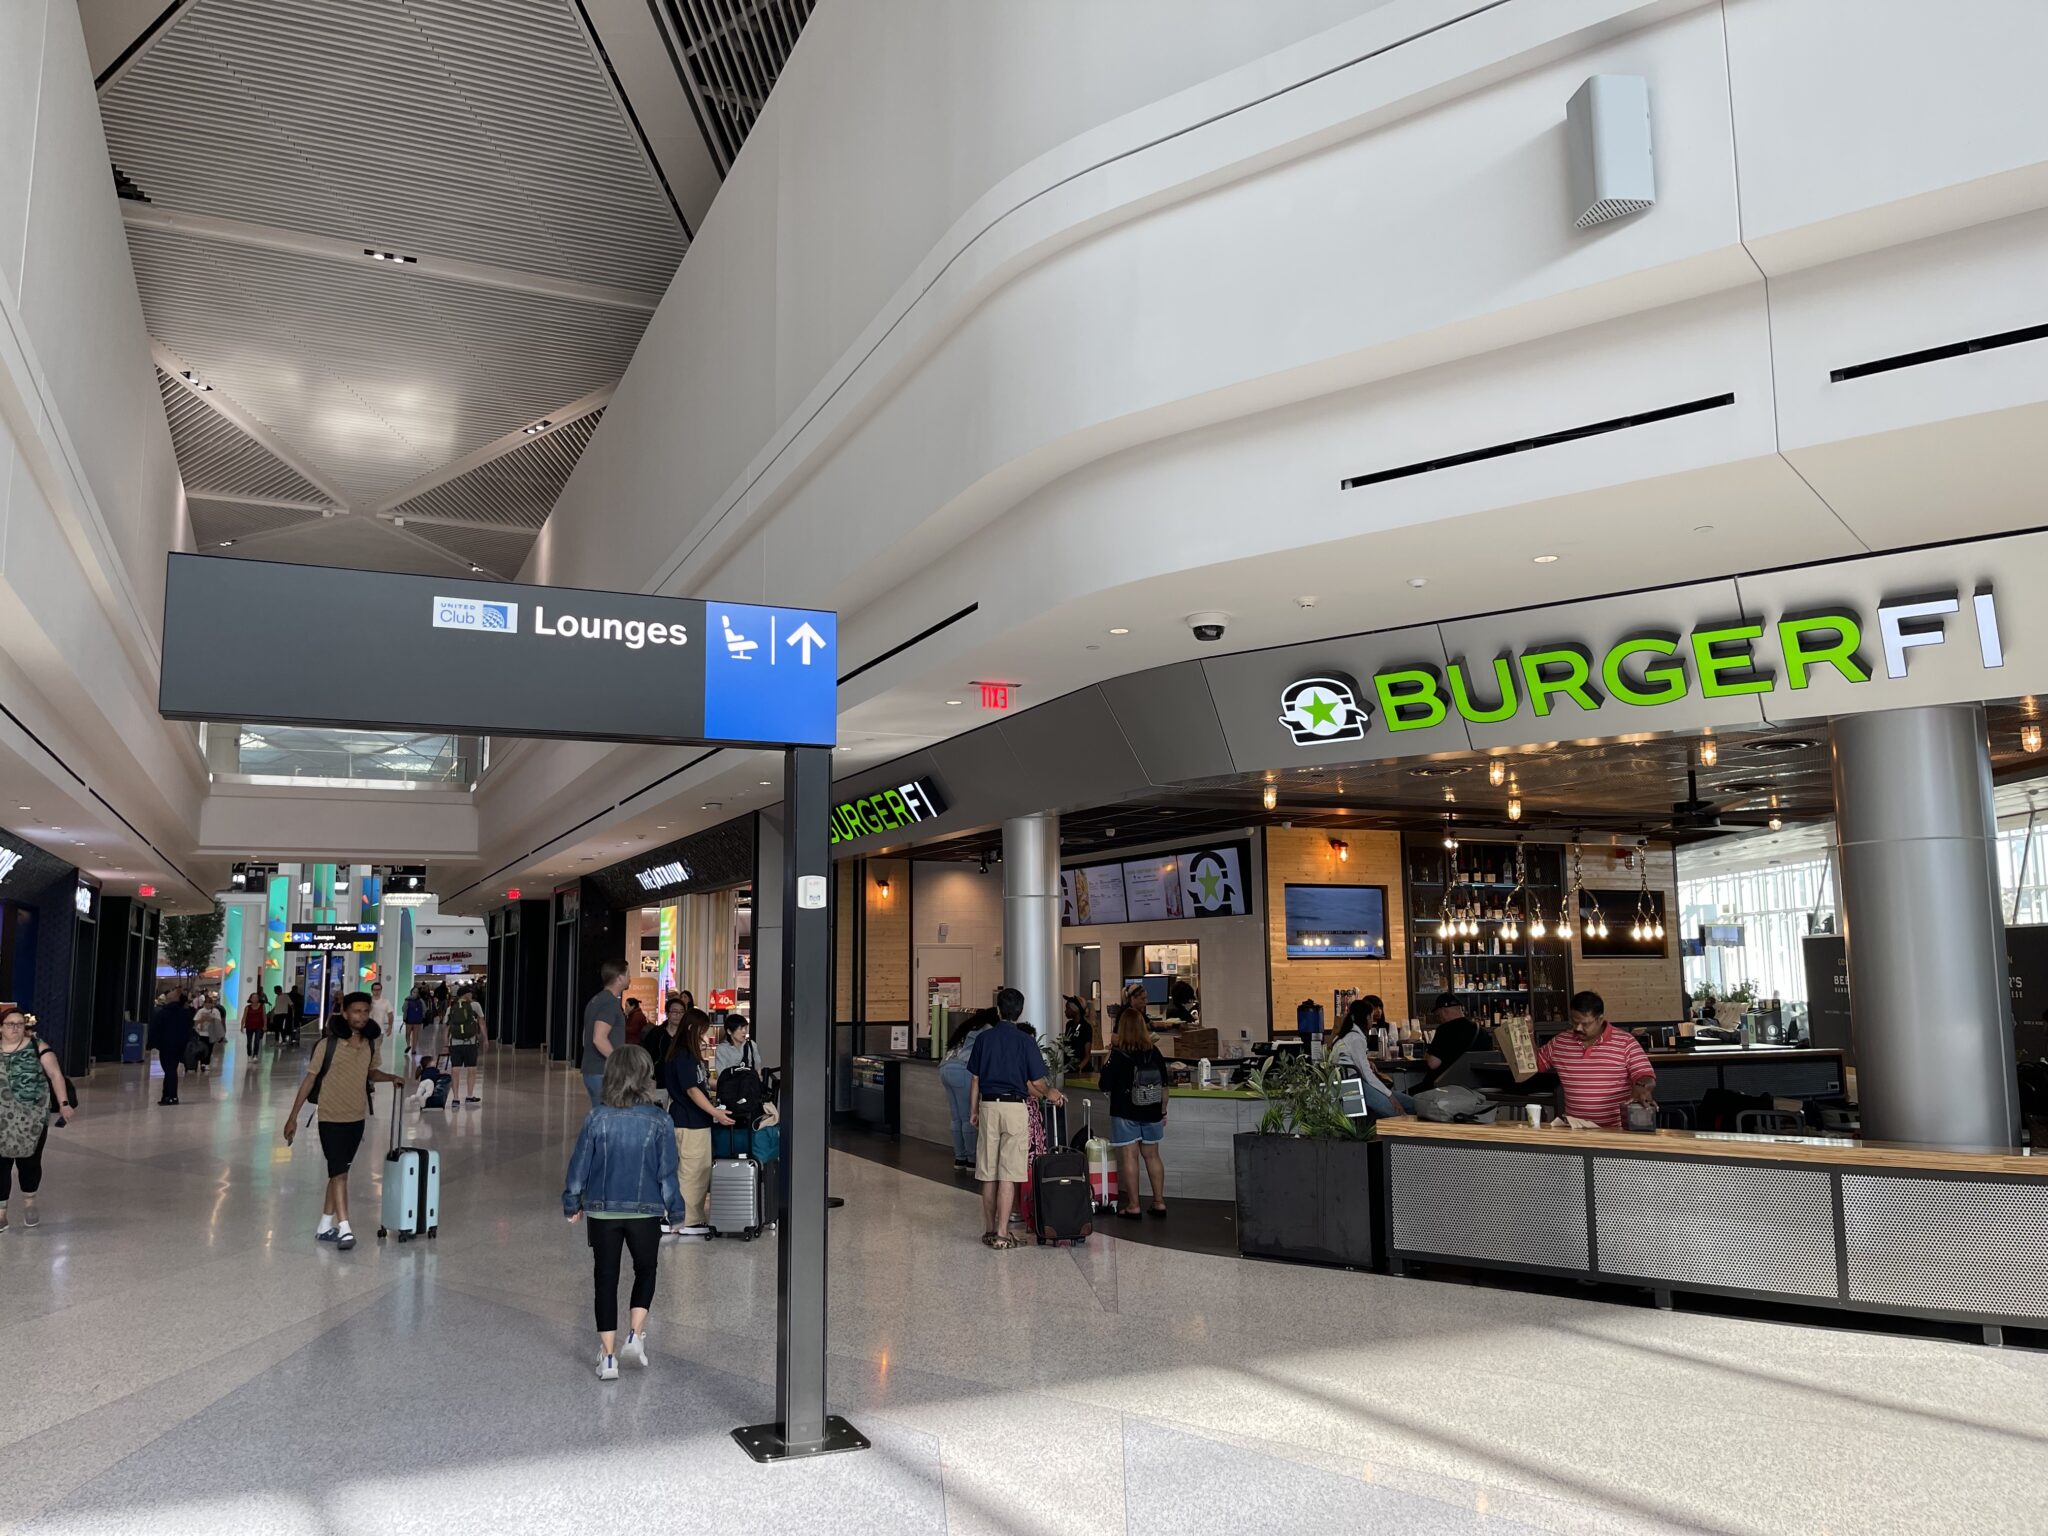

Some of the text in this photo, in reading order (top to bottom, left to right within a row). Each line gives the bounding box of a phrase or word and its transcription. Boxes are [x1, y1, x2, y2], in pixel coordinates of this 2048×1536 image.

[441, 602, 476, 610] UNITED
[440, 609, 475, 625] Club
[535, 606, 688, 649] Lounges
[1373, 587, 2004, 732] BURGERFI
[317, 942, 352, 950] A27-A34
